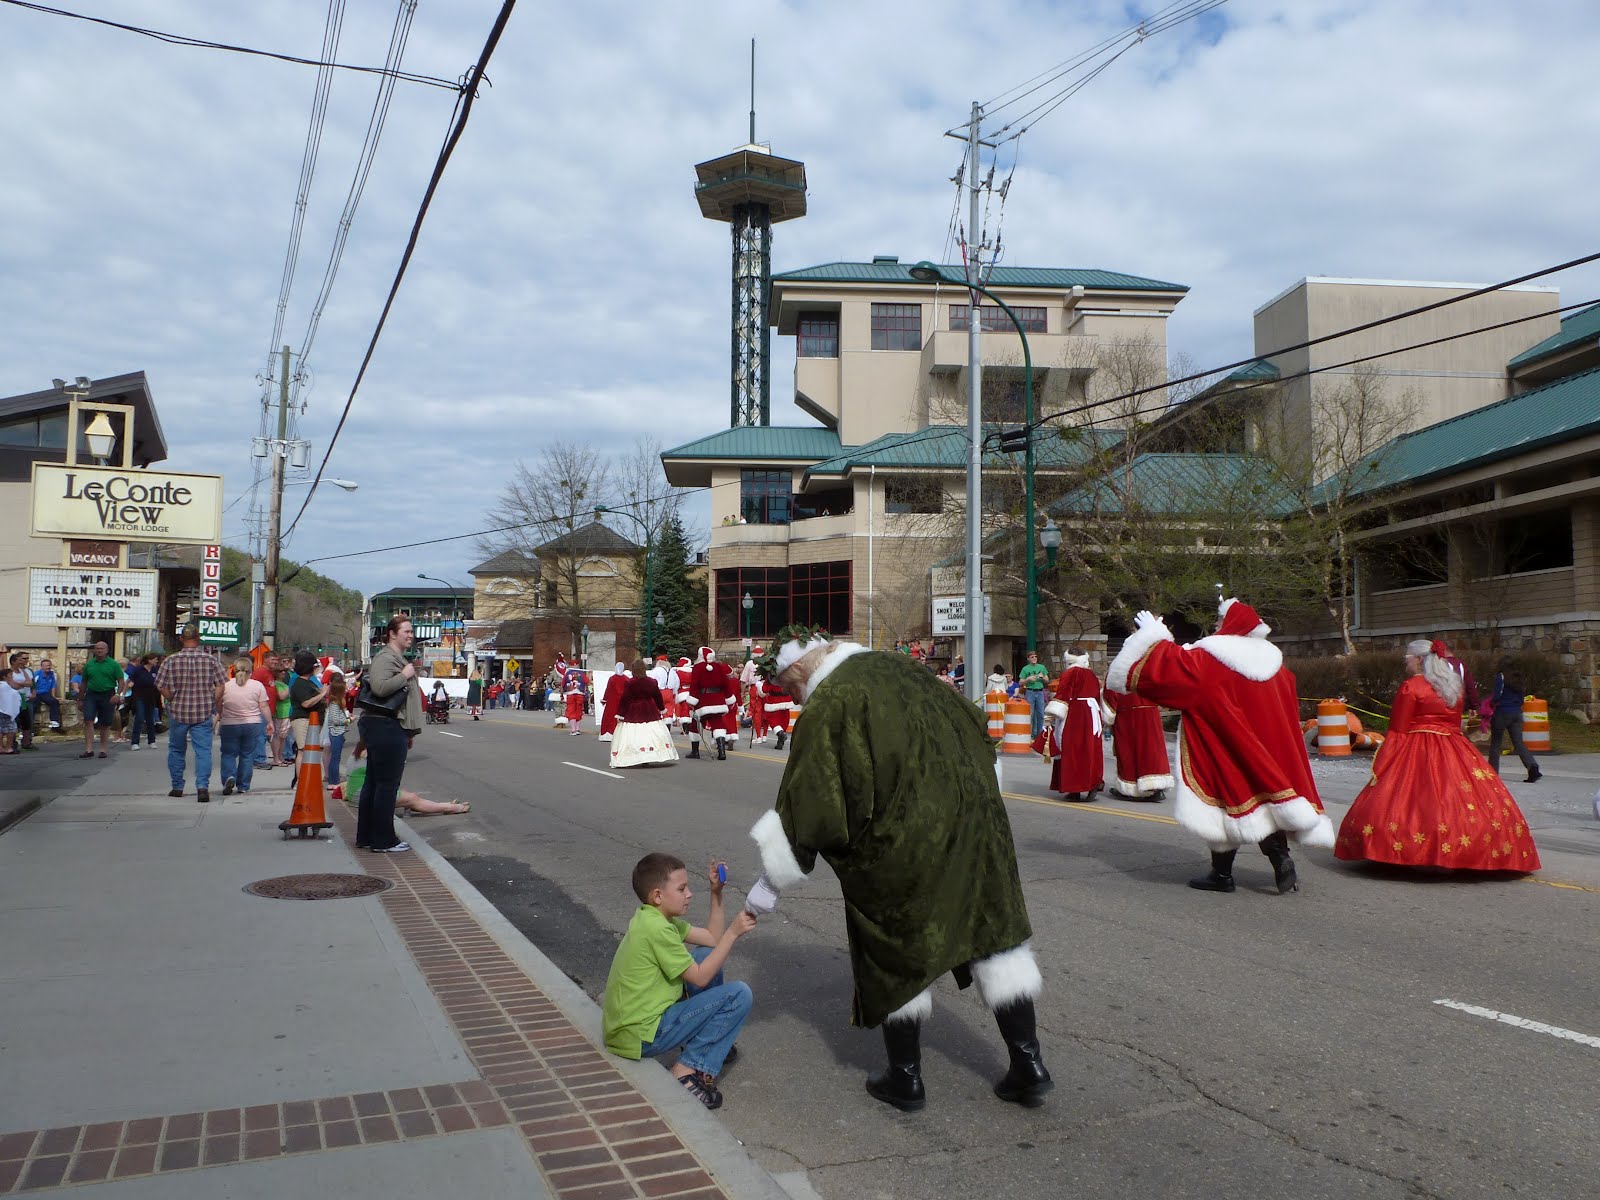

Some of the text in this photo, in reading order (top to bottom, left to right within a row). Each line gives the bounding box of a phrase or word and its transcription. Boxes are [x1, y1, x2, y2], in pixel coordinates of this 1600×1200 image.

[90, 492, 164, 529] View
[107, 523, 170, 533] MOTOR LODGE
[70, 553, 118, 565] VACANCY
[204, 545, 219, 617] RUGS
[44, 585, 141, 597] CLEAN ROOMS
[49, 597, 132, 609] INDOOR POOL
[198, 620, 238, 636] PARK
